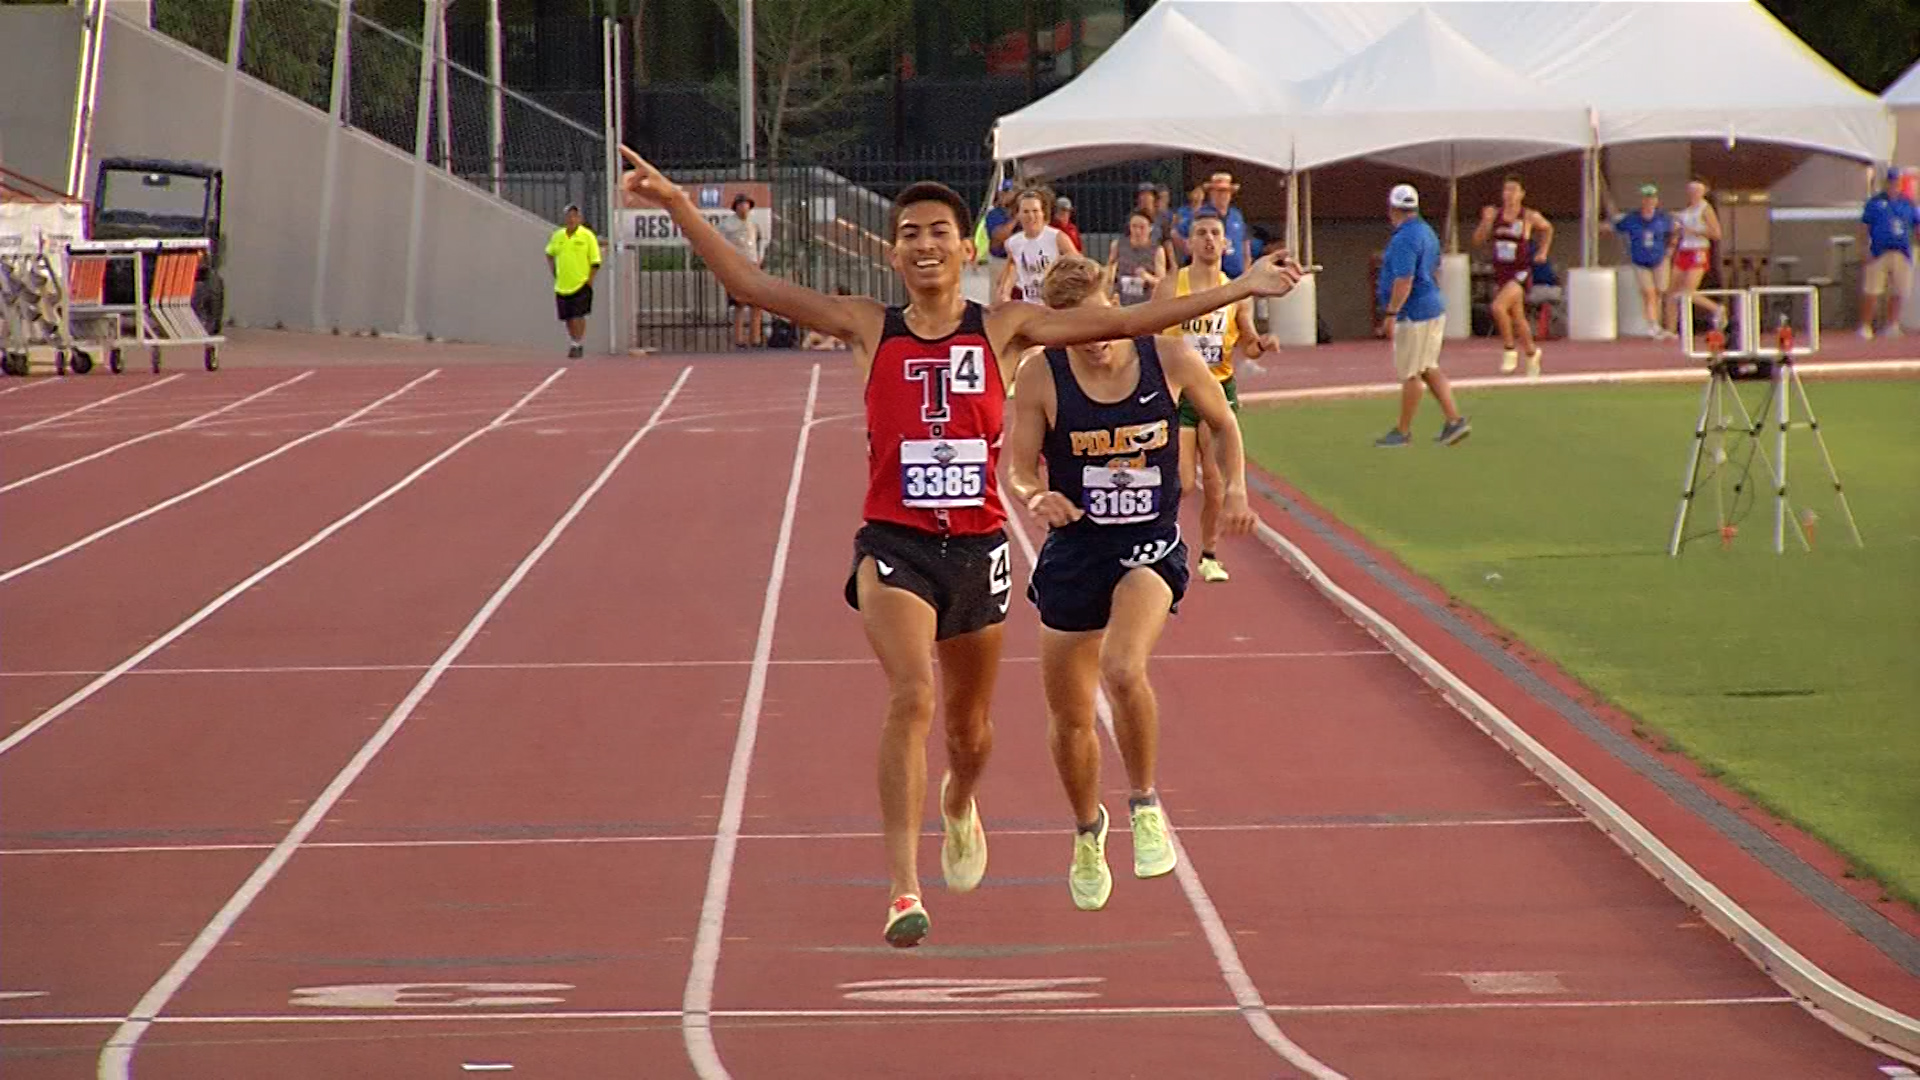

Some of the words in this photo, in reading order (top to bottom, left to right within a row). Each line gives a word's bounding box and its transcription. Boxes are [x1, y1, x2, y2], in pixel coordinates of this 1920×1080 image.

[955, 350, 979, 388] 4
[906, 466, 981, 496] 3385
[1090, 489, 1153, 515] 3163
[994, 550, 1011, 585] 4
[288, 983, 576, 1008] 3
